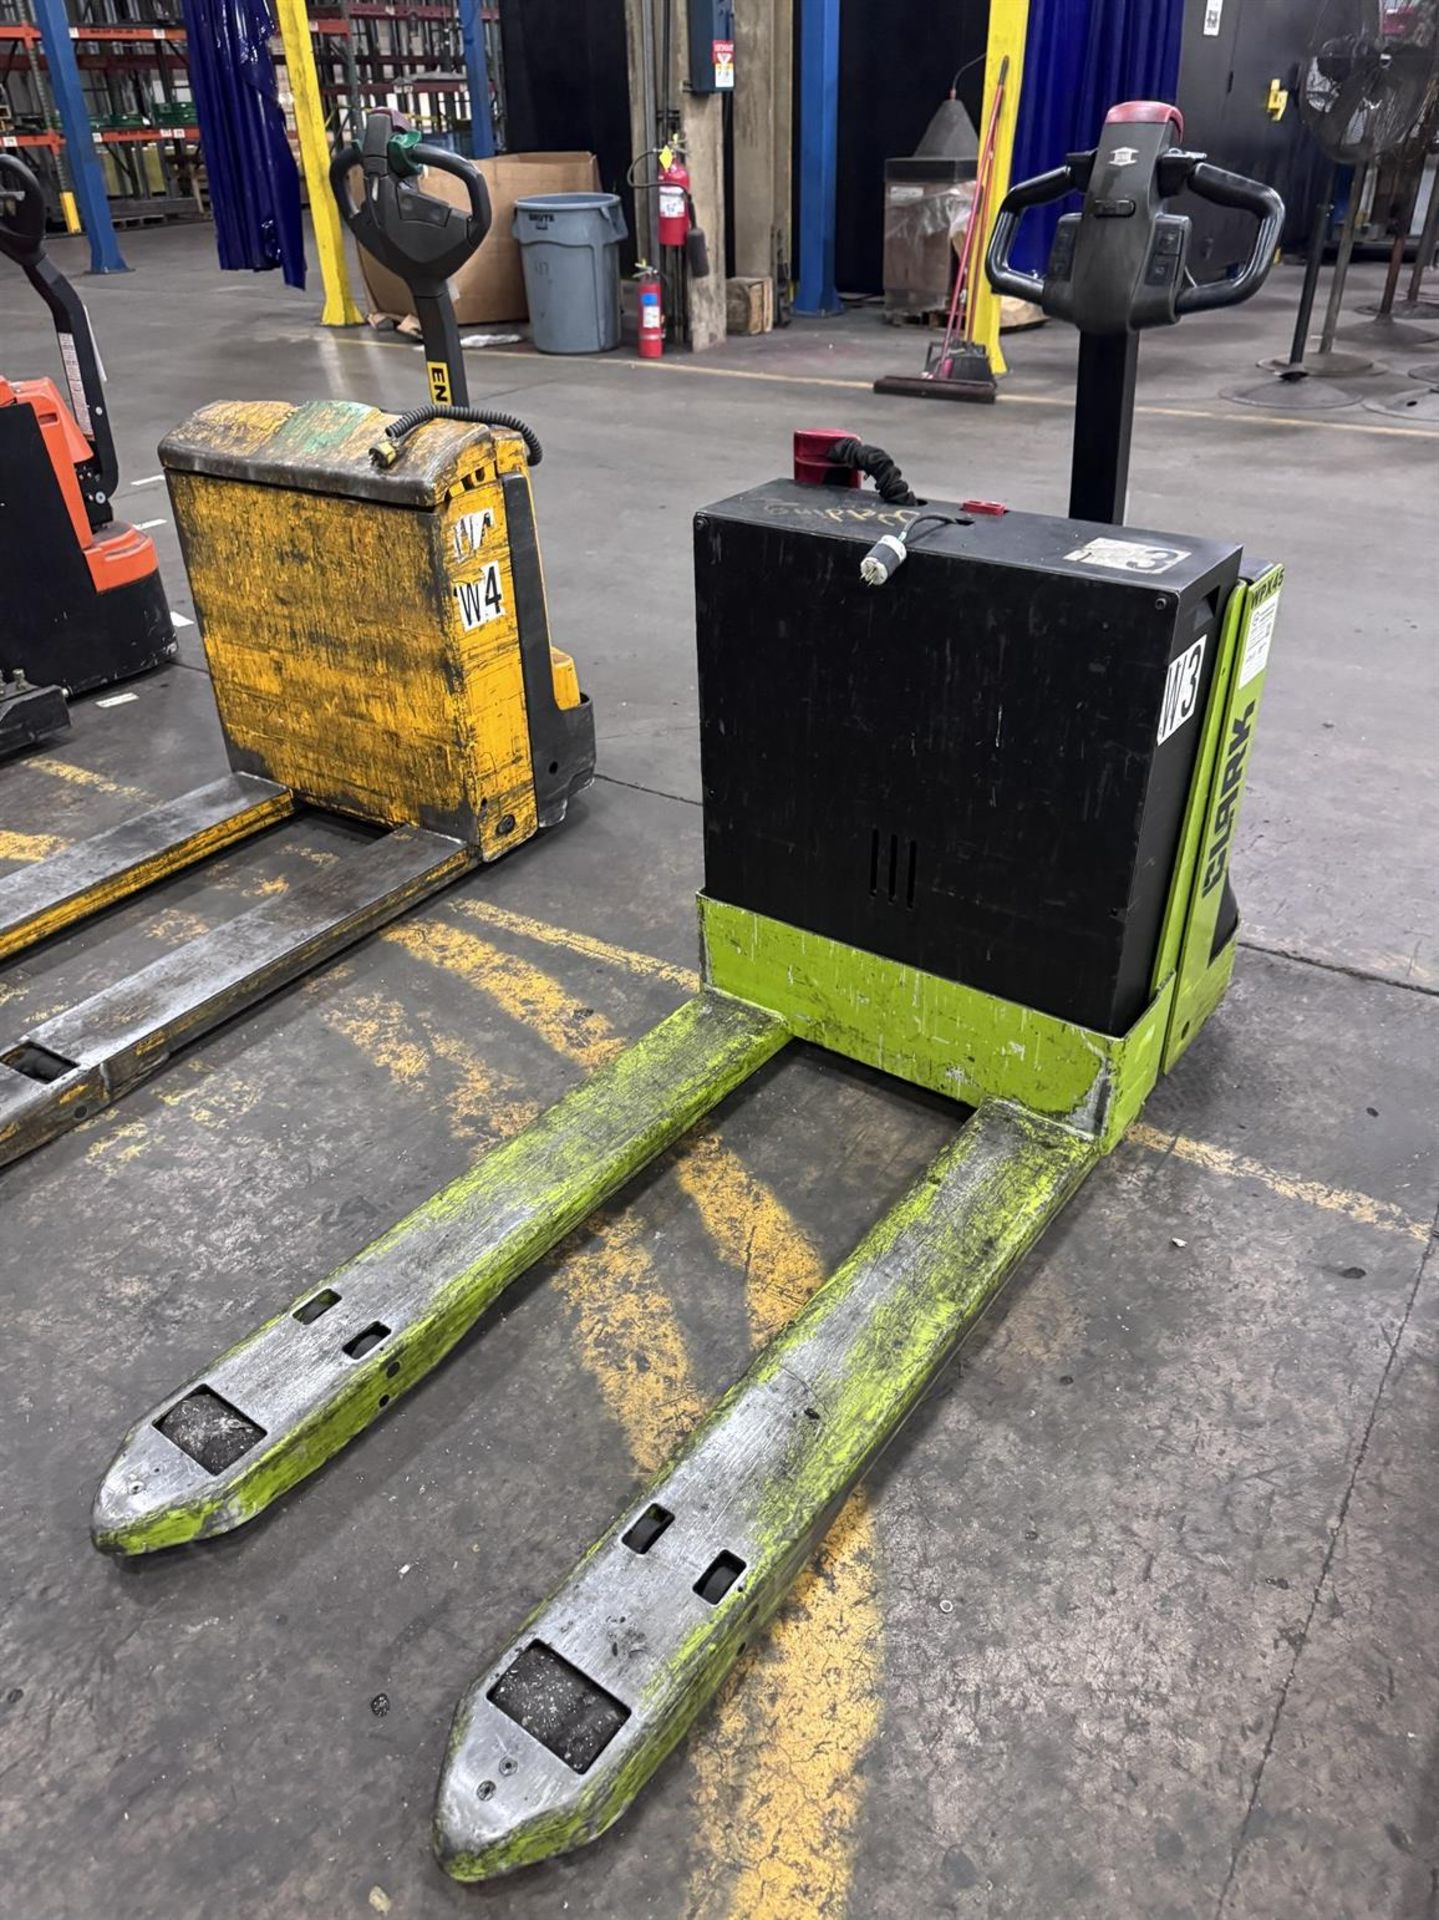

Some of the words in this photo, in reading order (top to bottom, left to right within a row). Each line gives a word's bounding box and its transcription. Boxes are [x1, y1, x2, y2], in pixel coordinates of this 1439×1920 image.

[458, 566, 502, 627] W4
[1251, 567, 1285, 610] WPX45
[1161, 644, 1203, 738] W3
[1201, 698, 1256, 898] CLARK
